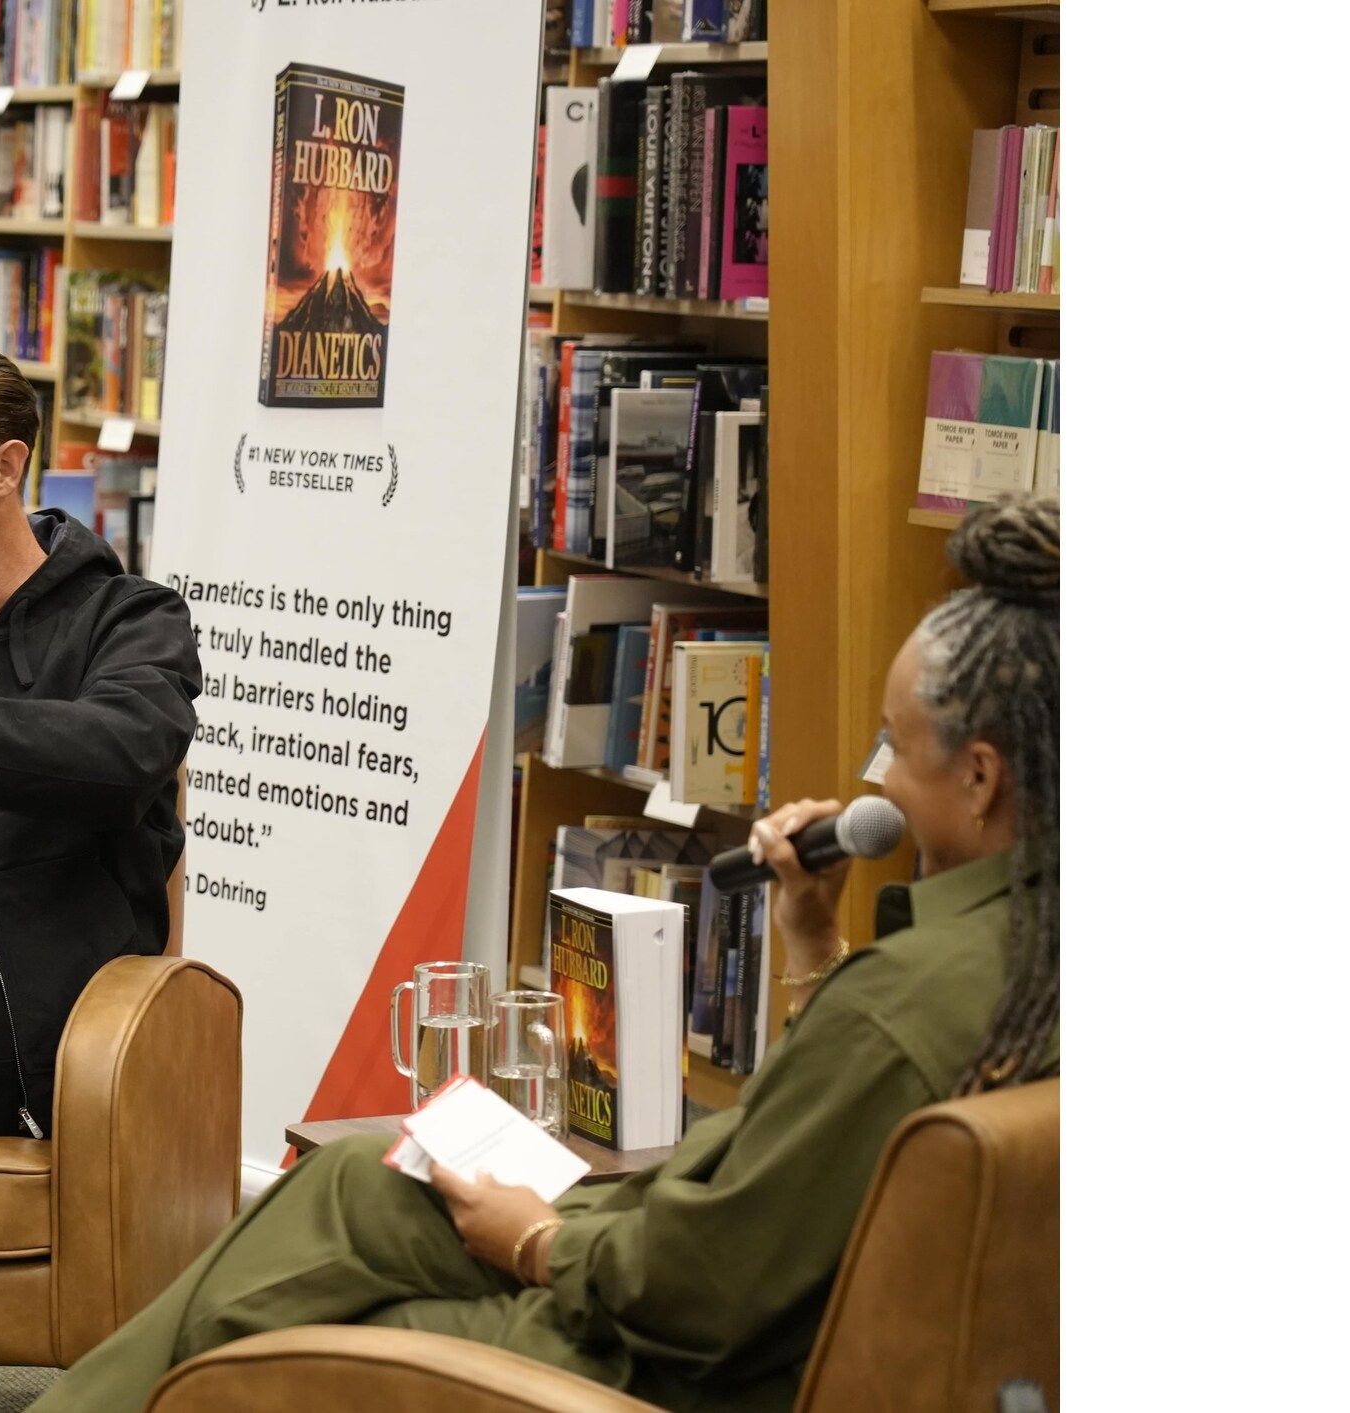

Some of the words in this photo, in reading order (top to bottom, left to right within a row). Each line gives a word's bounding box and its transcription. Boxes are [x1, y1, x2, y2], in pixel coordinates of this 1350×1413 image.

[312, 93, 331, 139] L.
[333, 97, 381, 147] RON
[645, 104, 658, 170] LOUIS
[293, 140, 393, 194] HUBBARD
[641, 175, 657, 276] VUITTON
[275, 330, 382, 380] DIANETICS
[937, 423, 957, 434] TOMOE
[957, 425, 975, 435] RIVER
[945, 435, 963, 444] PAPER
[985, 428, 1003, 439] TOMOE
[1003, 431, 1018, 440] RIVER
[992, 440, 1008, 450] PAPER
[248, 446, 260, 462] #1
[263, 447, 296, 465] NEW
[300, 450, 338, 469] YORK
[342, 453, 384, 473] TIMES
[269, 470, 354, 492] BESTSELLER
[270, 584, 286, 612] is
[293, 588, 329, 617] the
[336, 595, 385, 629] only
[392, 599, 452, 638] thing
[210, 626, 253, 660] truly
[259, 631, 348, 668] handled
[355, 644, 392, 675] the
[204, 672, 227, 699] tal
[232, 675, 315, 713] barriers
[322, 687, 408, 732] holding
[195, 716, 244, 754] back,
[251, 725, 350, 767] irrational
[357, 742, 419, 784] fears,
[257, 781, 359, 818] emotions
[365, 799, 409, 827] and
[196, 873, 267, 912] Dohring
[571, 919, 596, 955] RON
[553, 943, 608, 990] HUBBARD
[569, 1080, 612, 1127] NETICS
